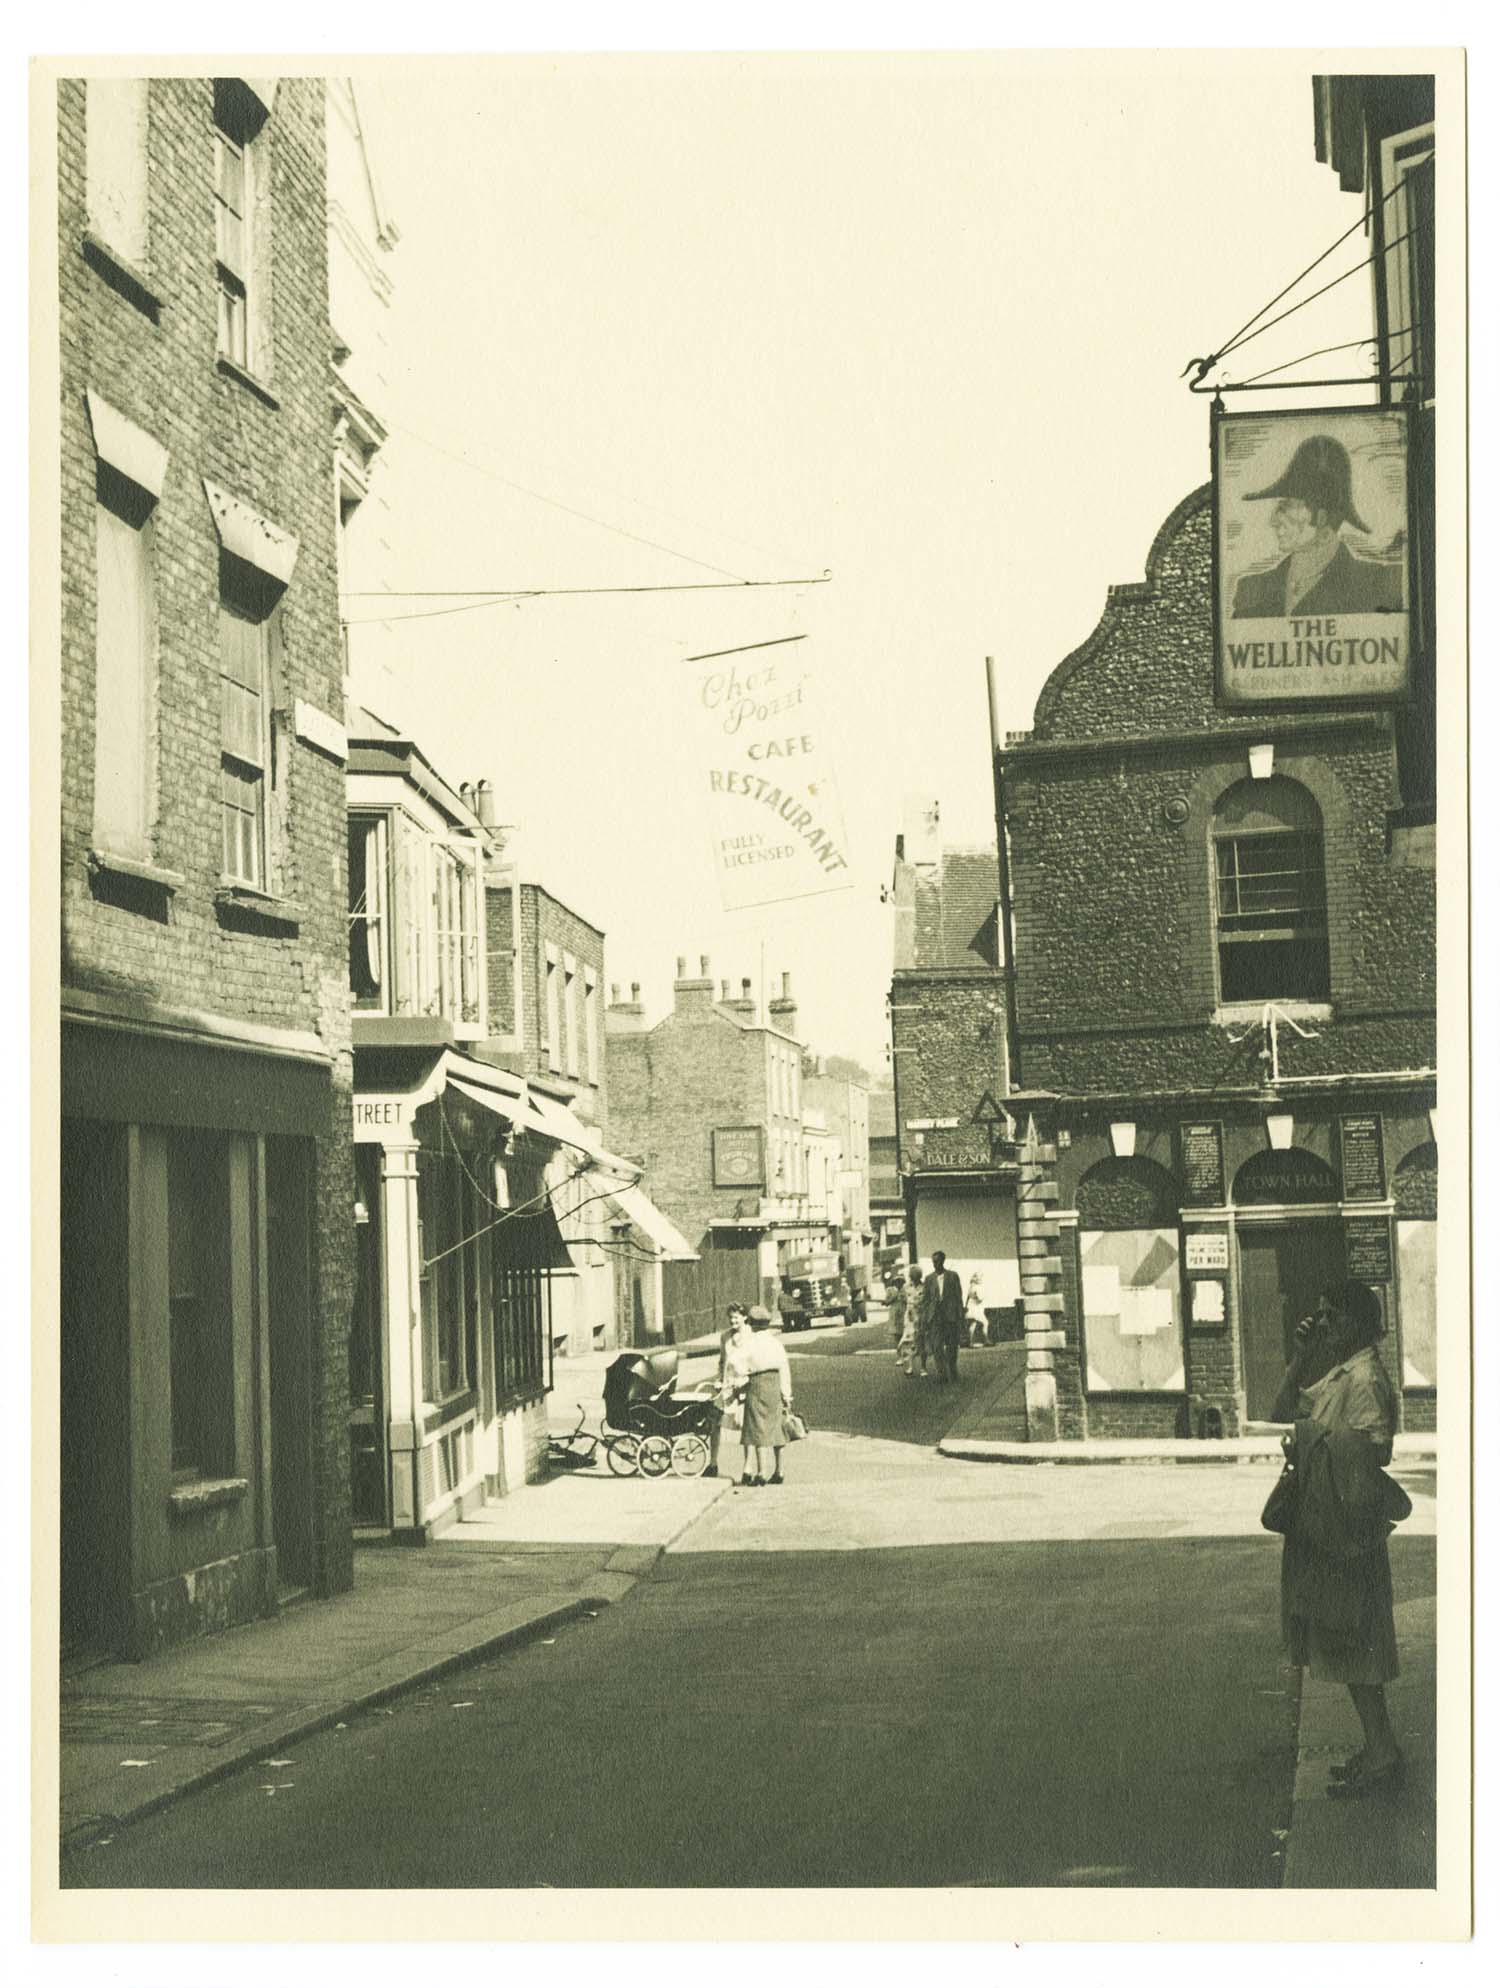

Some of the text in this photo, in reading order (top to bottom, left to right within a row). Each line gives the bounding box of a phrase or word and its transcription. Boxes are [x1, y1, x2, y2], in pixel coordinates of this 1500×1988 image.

[1290, 618, 1338, 638] THE
[1227, 637, 1400, 670] WELLINGTON
[701, 665, 777, 709] Chez
[723, 676, 809, 735] Pozzi
[747, 734, 815, 761] CAFE
[708, 768, 849, 874] RESTAURANT
[720, 832, 766, 851] FULLY
[723, 845, 795, 869] LICENSED
[355, 1102, 403, 1125] TREET
[926, 1152, 957, 1166] DALE
[968, 1151, 991, 1165] SON
[1244, 1172, 1334, 1191] TOWN HALL
